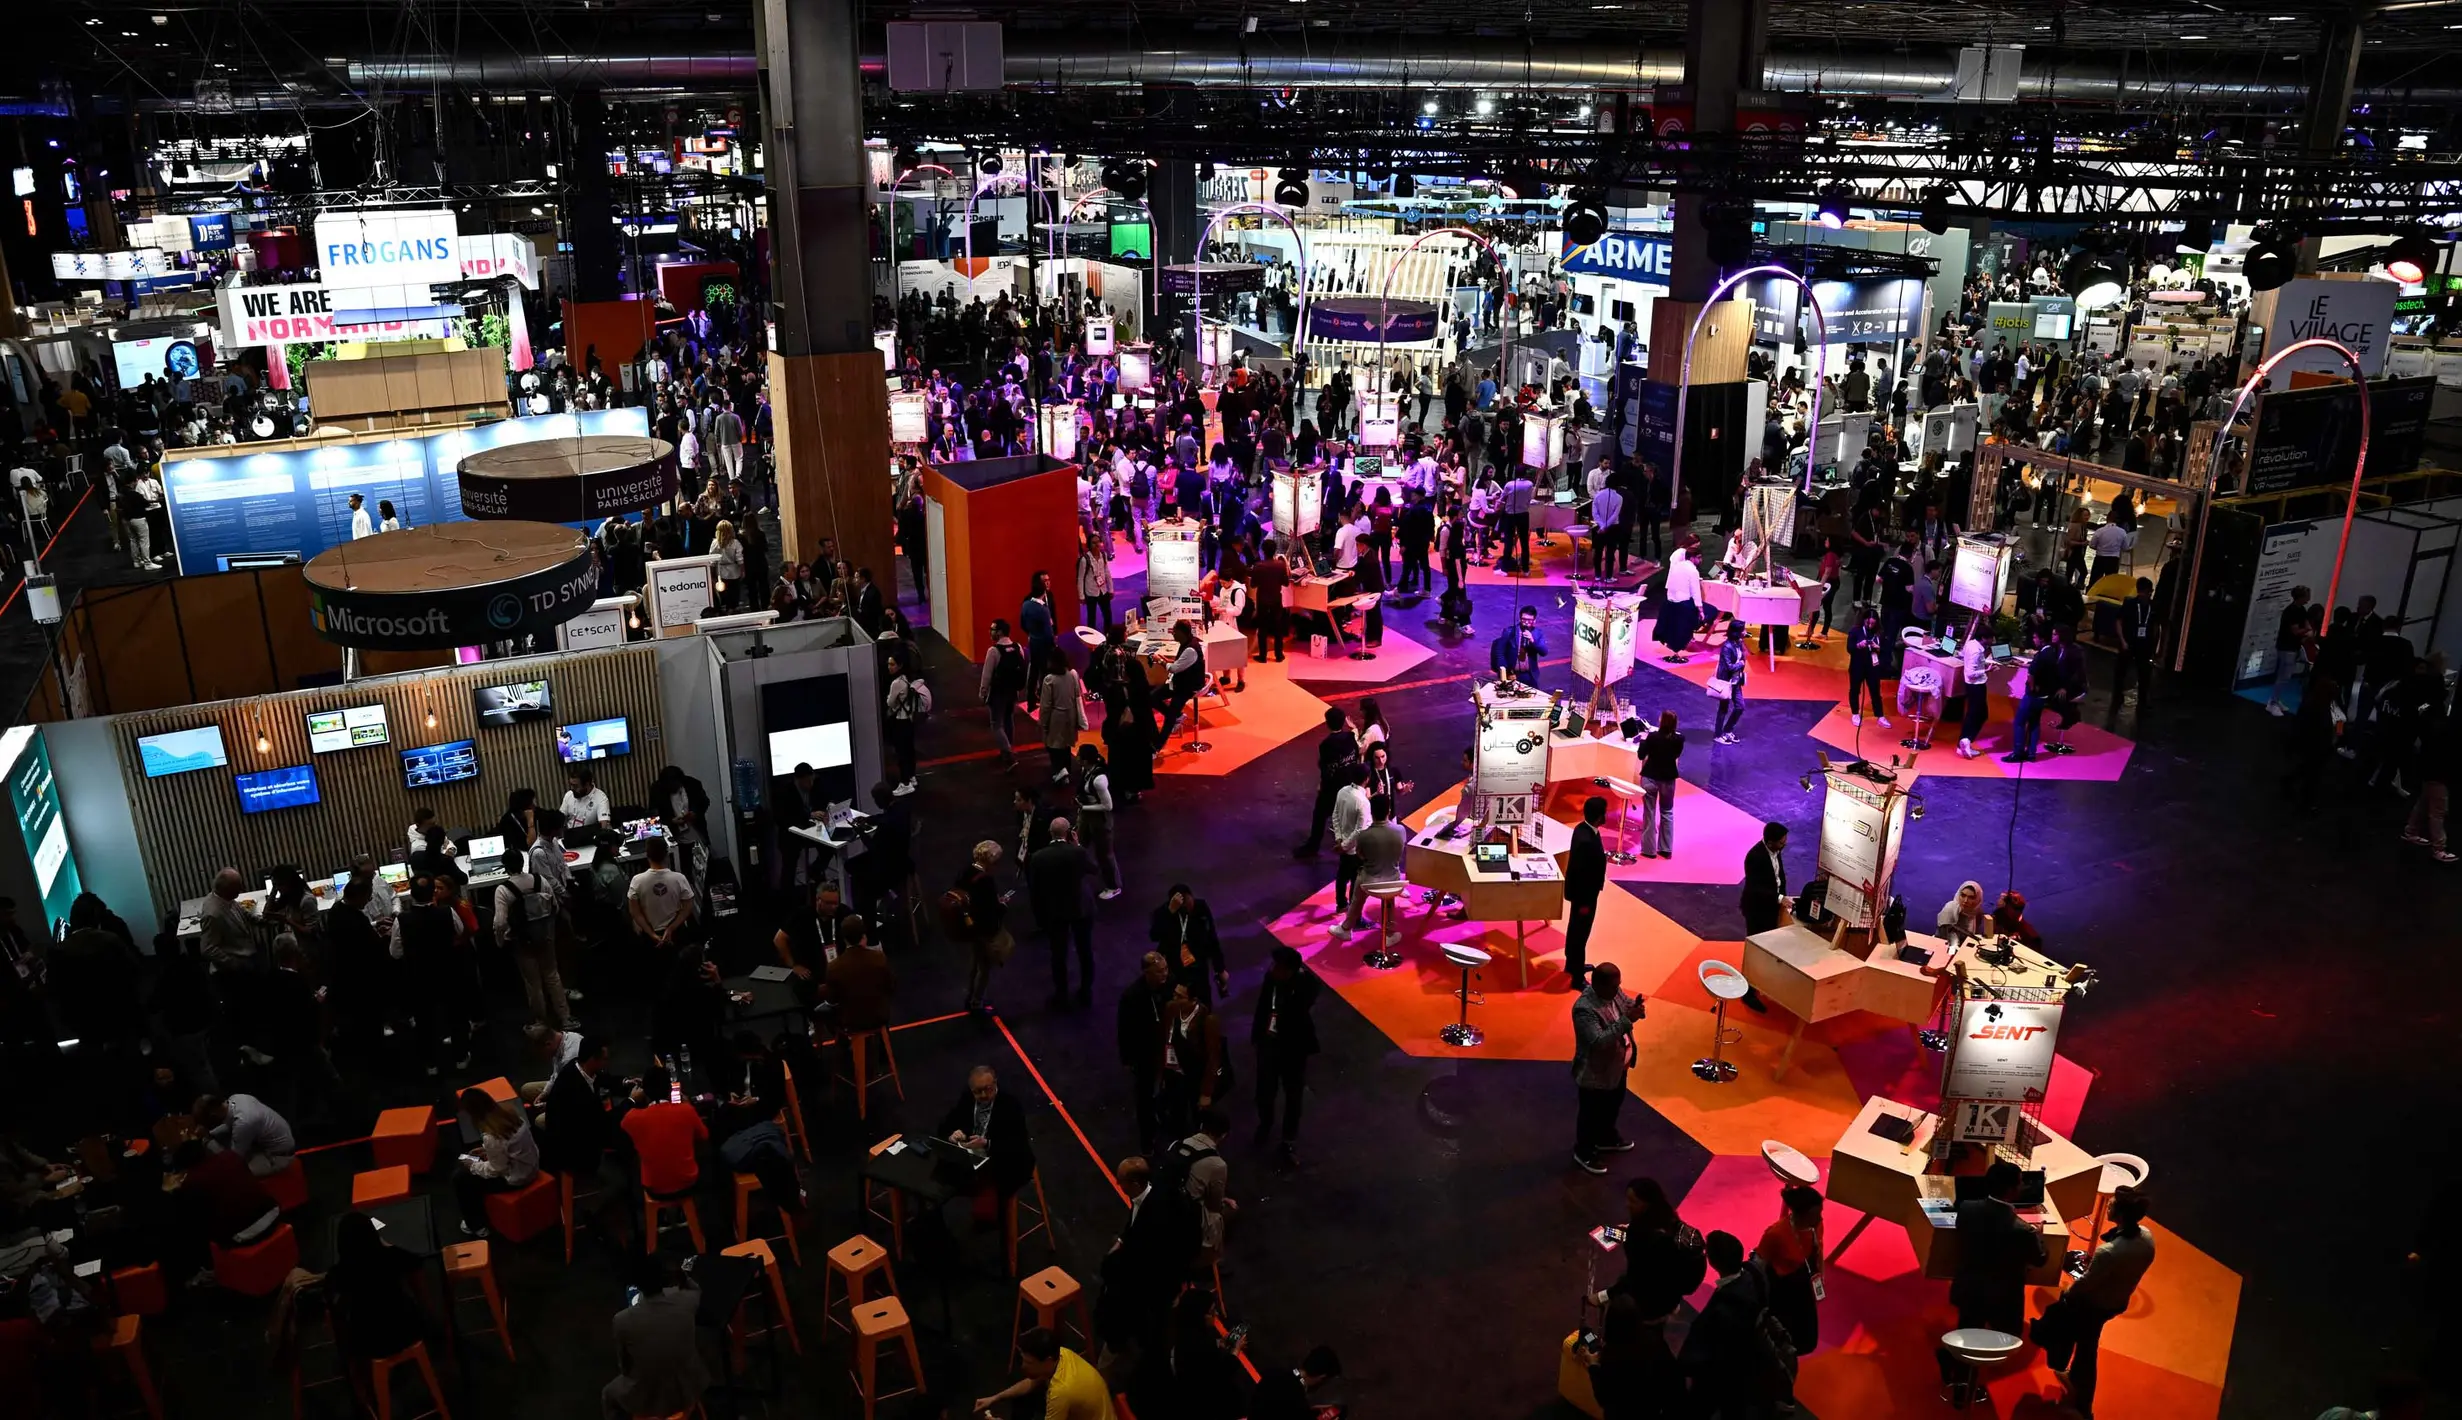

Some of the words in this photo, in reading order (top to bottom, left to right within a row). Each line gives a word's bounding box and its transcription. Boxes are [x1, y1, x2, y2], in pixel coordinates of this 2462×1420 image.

[327, 237, 450, 267] FROGANS
[242, 292, 281, 318] WE
[290, 289, 333, 315] ARE
[2308, 295, 2330, 320] LE
[1994, 316, 2030, 329] #jobs
[596, 486, 664, 511] PARIS-SACLAY
[669, 580, 707, 593] edonia
[529, 591, 556, 613] TD
[326, 604, 450, 637] Microsoft
[1974, 1025, 2040, 1041] SENT
[1964, 1126, 2008, 1135] MILE
